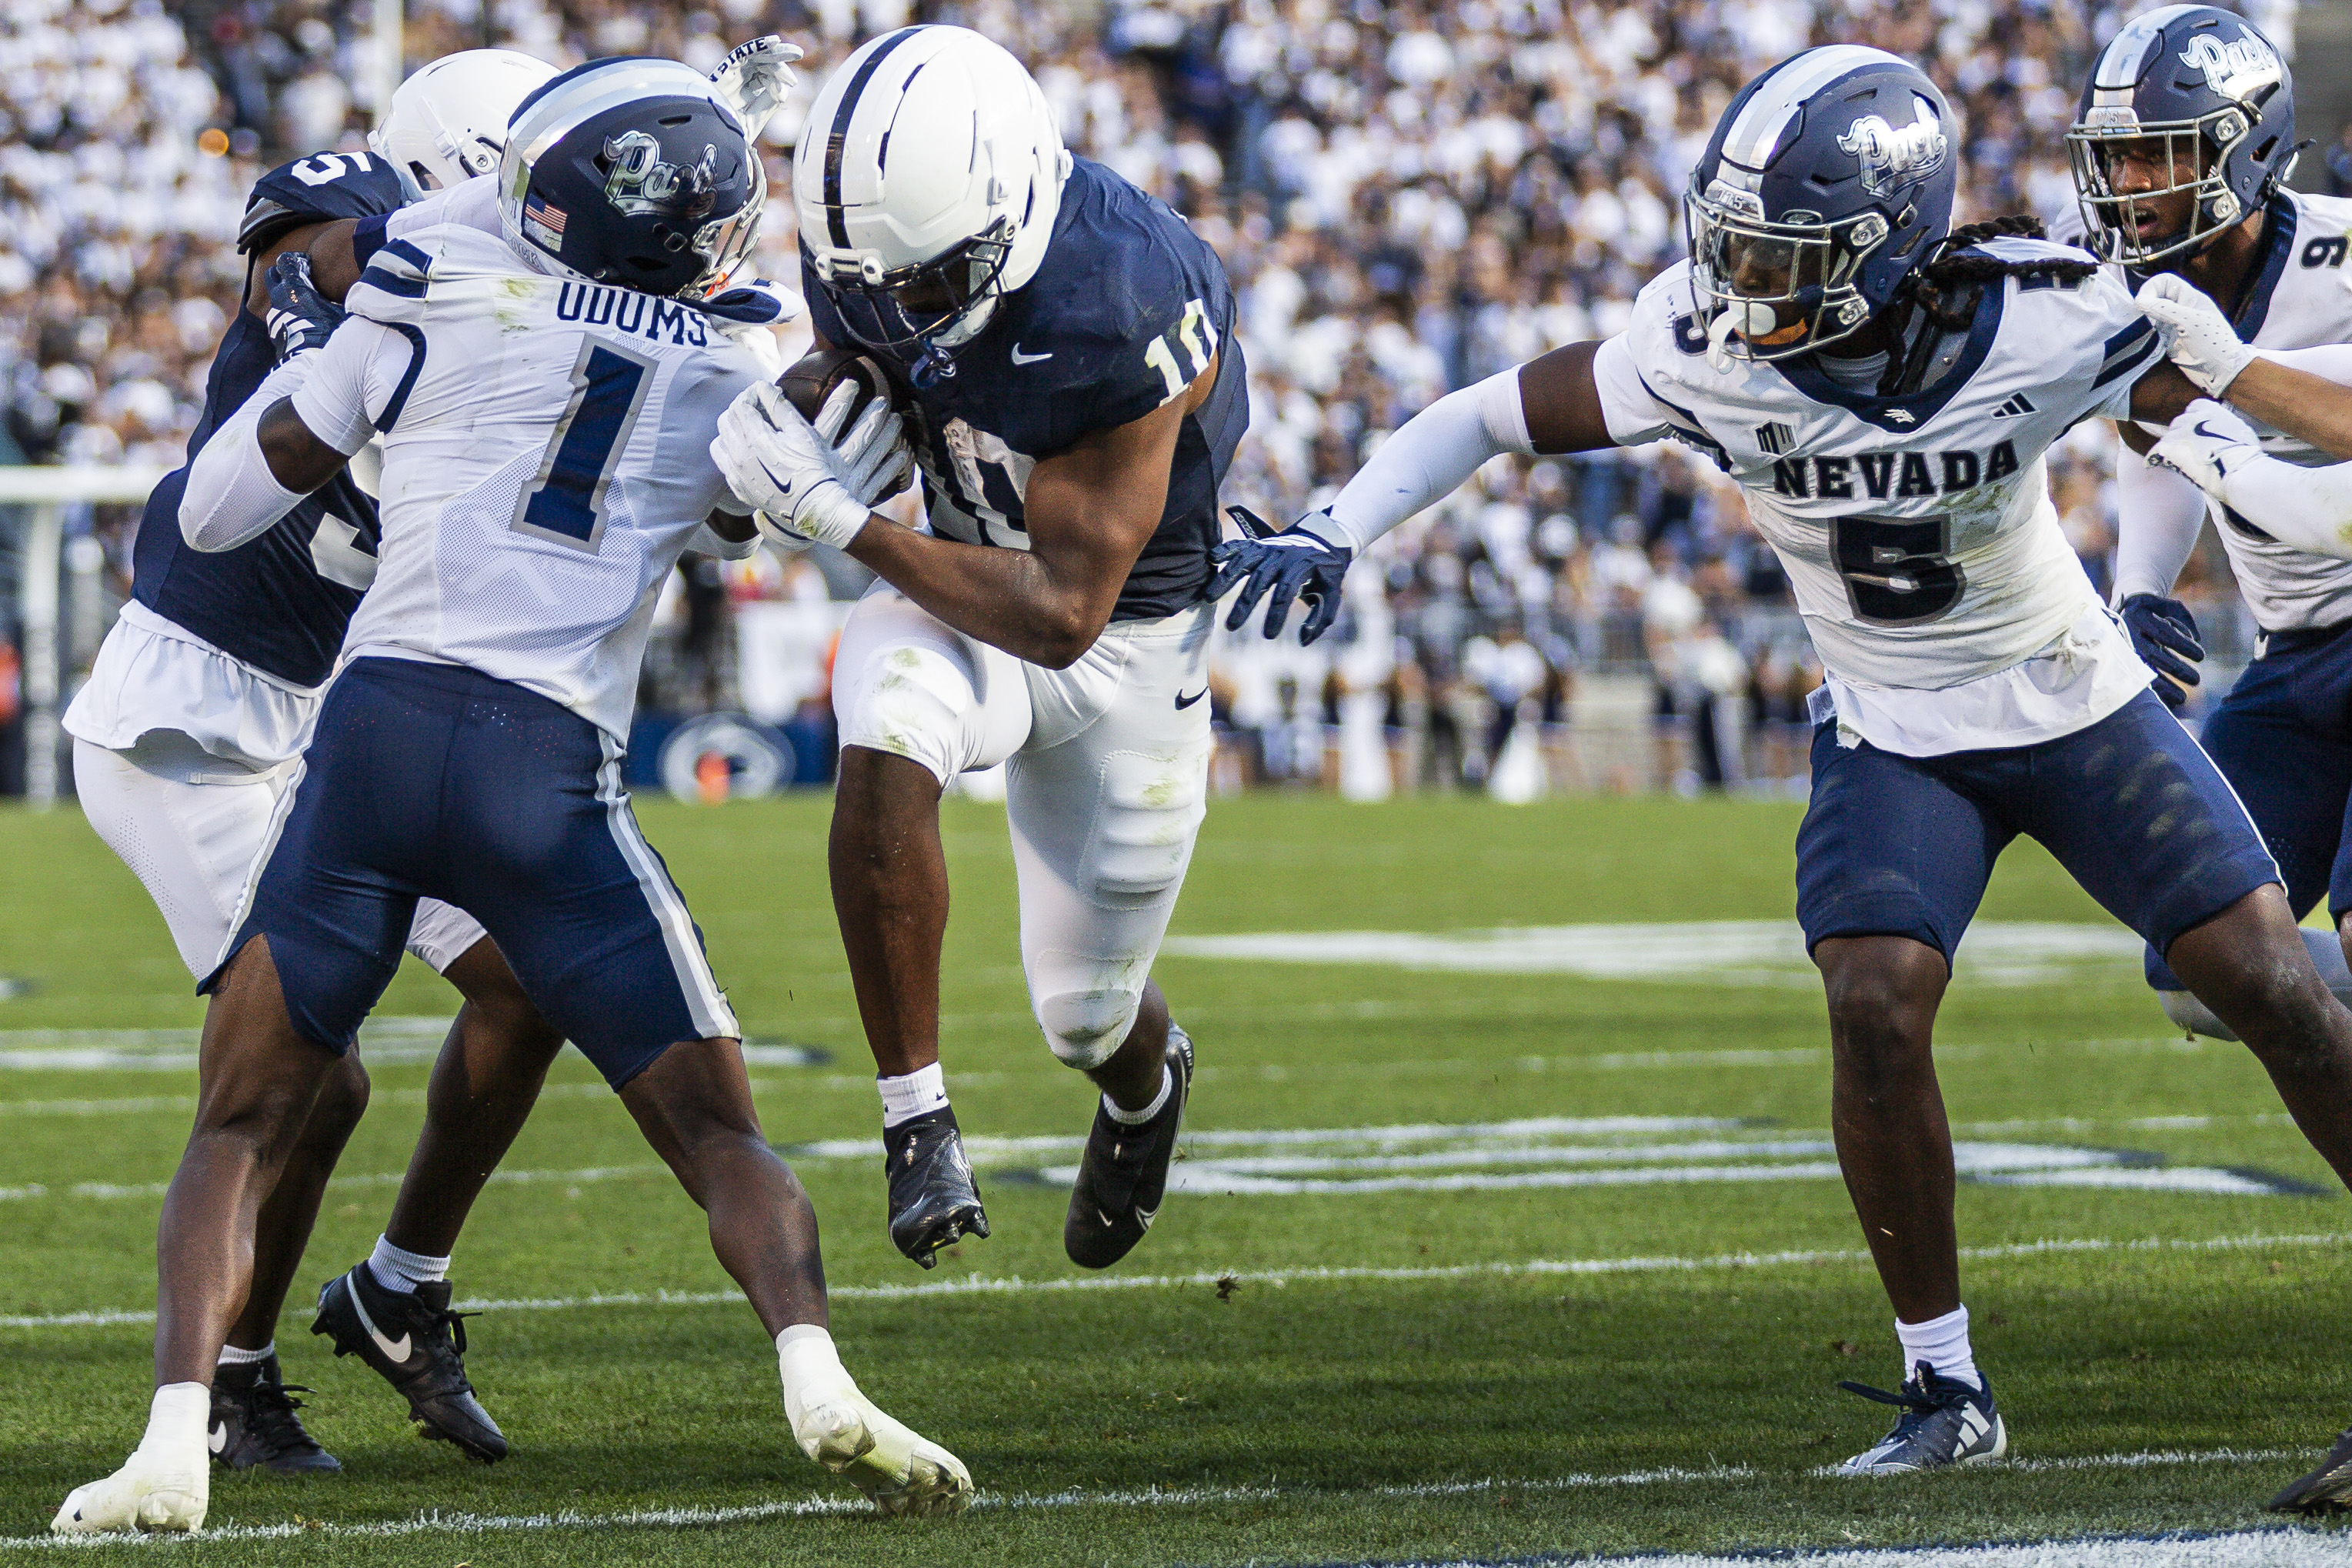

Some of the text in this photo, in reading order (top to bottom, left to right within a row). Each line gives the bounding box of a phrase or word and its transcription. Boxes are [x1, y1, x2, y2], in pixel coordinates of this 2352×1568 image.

[2298, 234, 2350, 269] 9
[1144, 298, 1219, 407] 10
[508, 332, 661, 556] 1
[1771, 436, 2020, 499] NEVADA
[1827, 514, 1967, 629] 5
